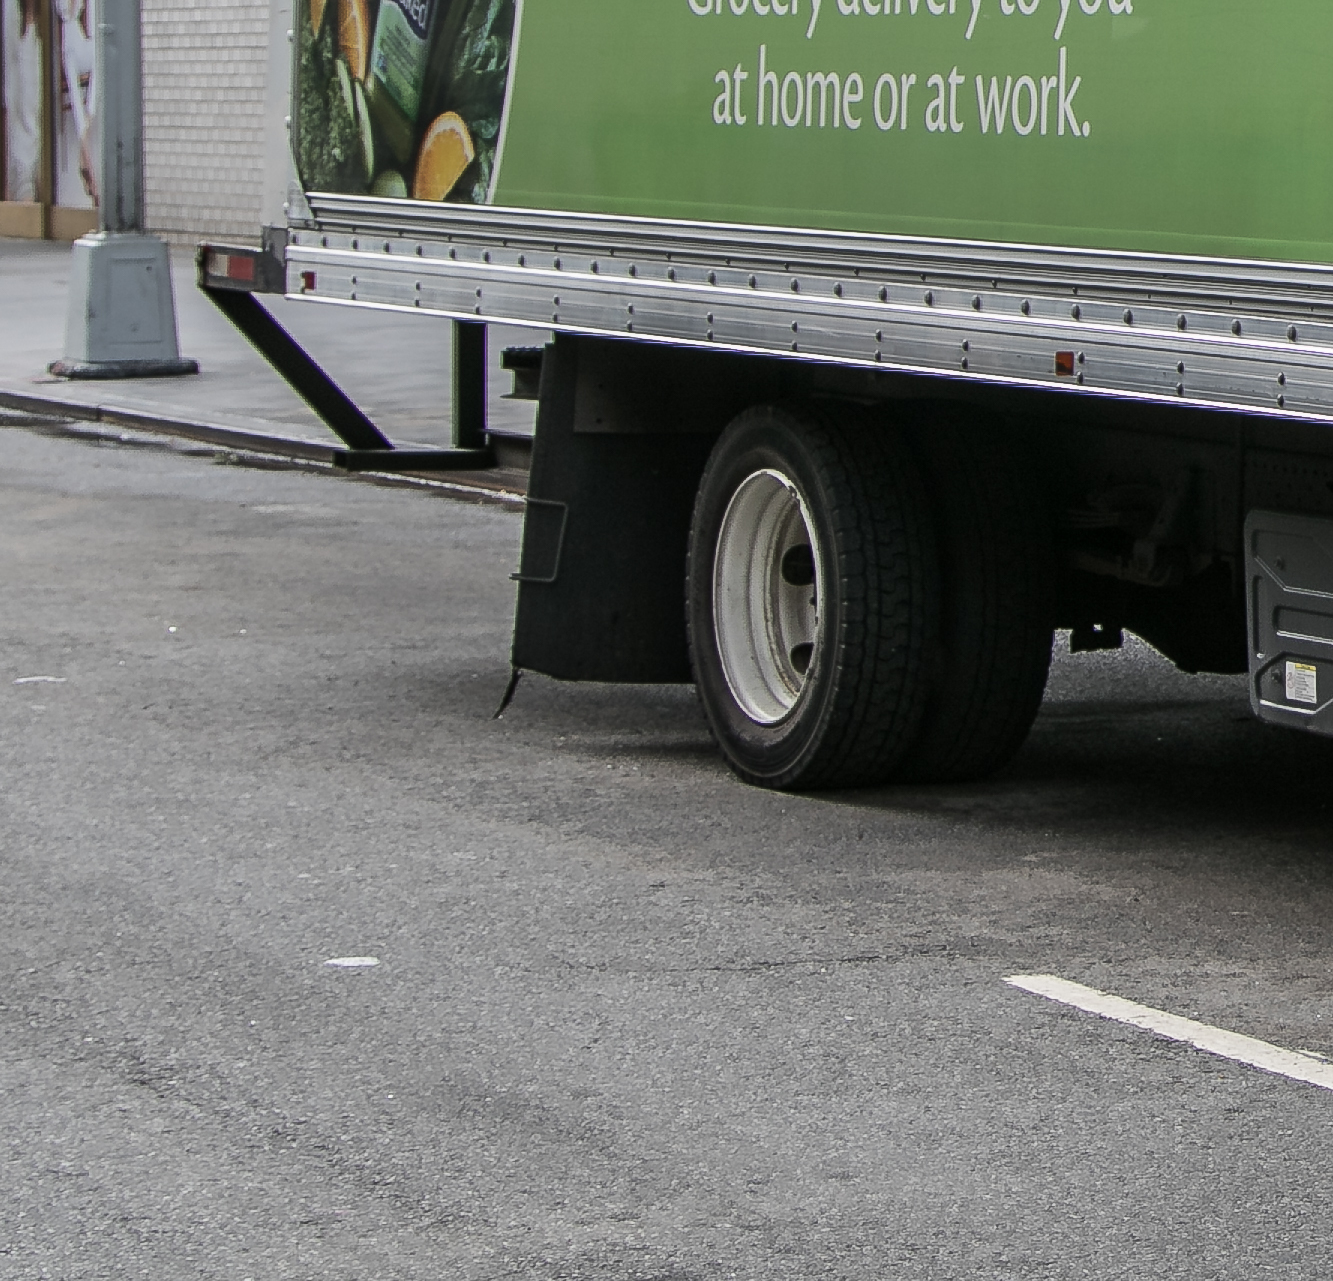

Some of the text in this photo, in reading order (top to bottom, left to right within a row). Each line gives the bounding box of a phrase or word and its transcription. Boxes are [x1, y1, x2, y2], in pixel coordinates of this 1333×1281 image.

[712, 44, 1091, 139] at home or at work.
